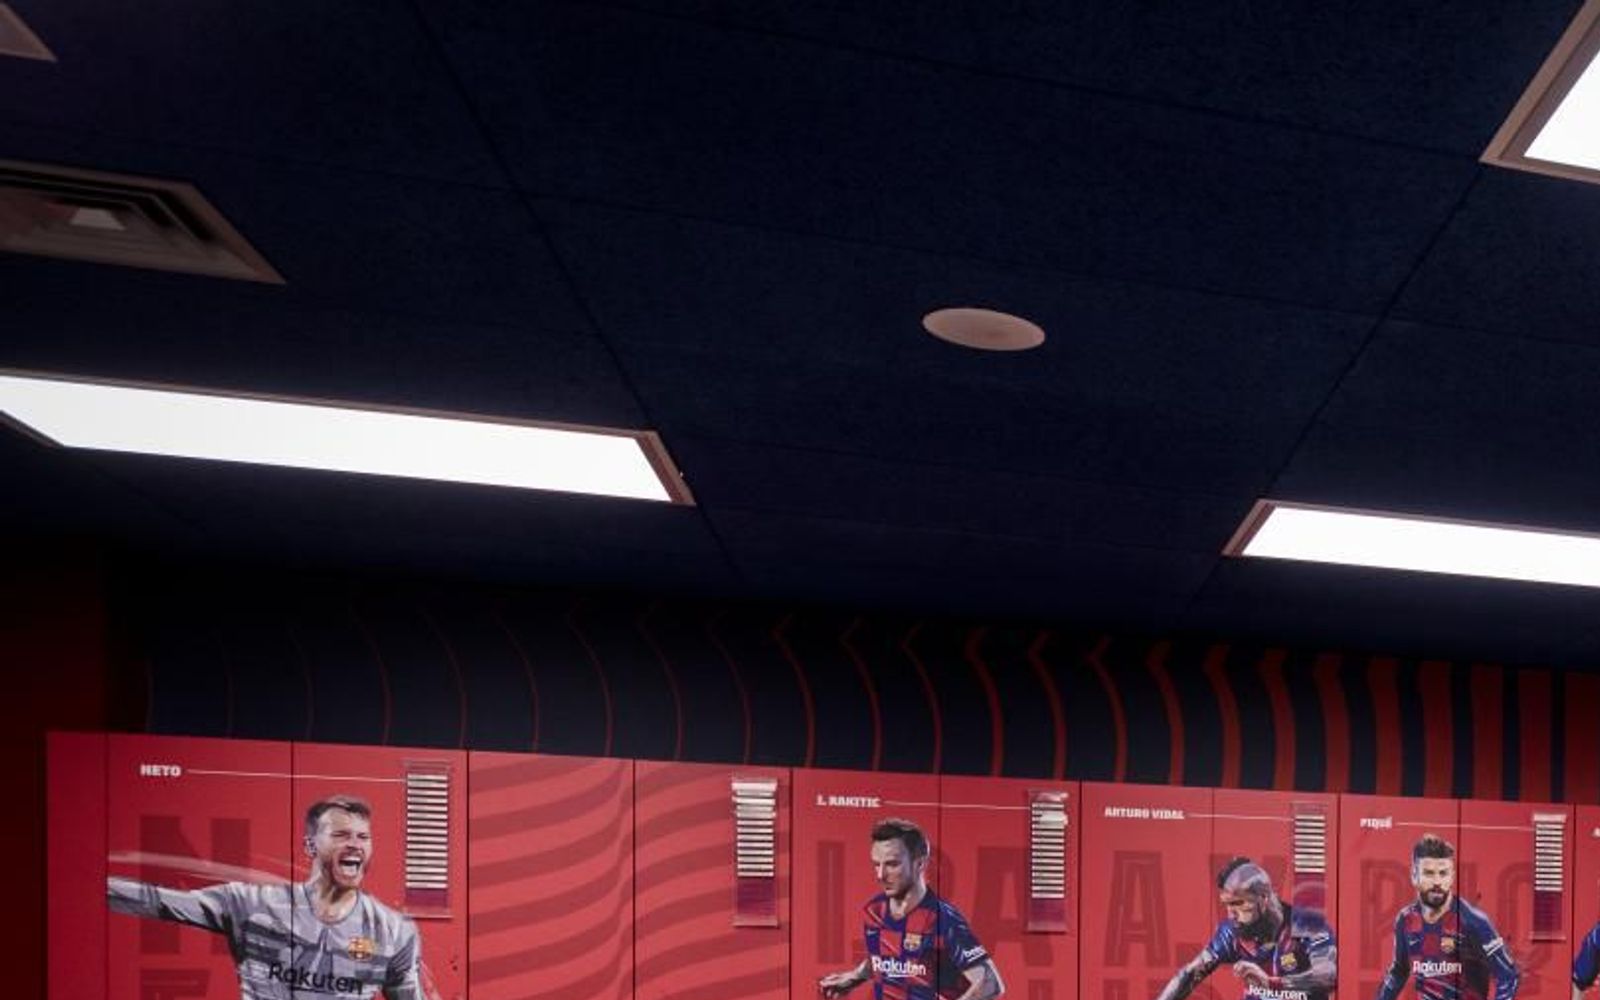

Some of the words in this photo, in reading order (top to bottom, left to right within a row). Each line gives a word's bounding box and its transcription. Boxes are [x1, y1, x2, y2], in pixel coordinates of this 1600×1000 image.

[140, 764, 182, 777] NETO
[1151, 809, 1184, 820] VIDAL
[871, 955, 927, 977] Rakuten
[1413, 961, 1462, 976] Rakuten
[269, 962, 363, 996] Rakuten
